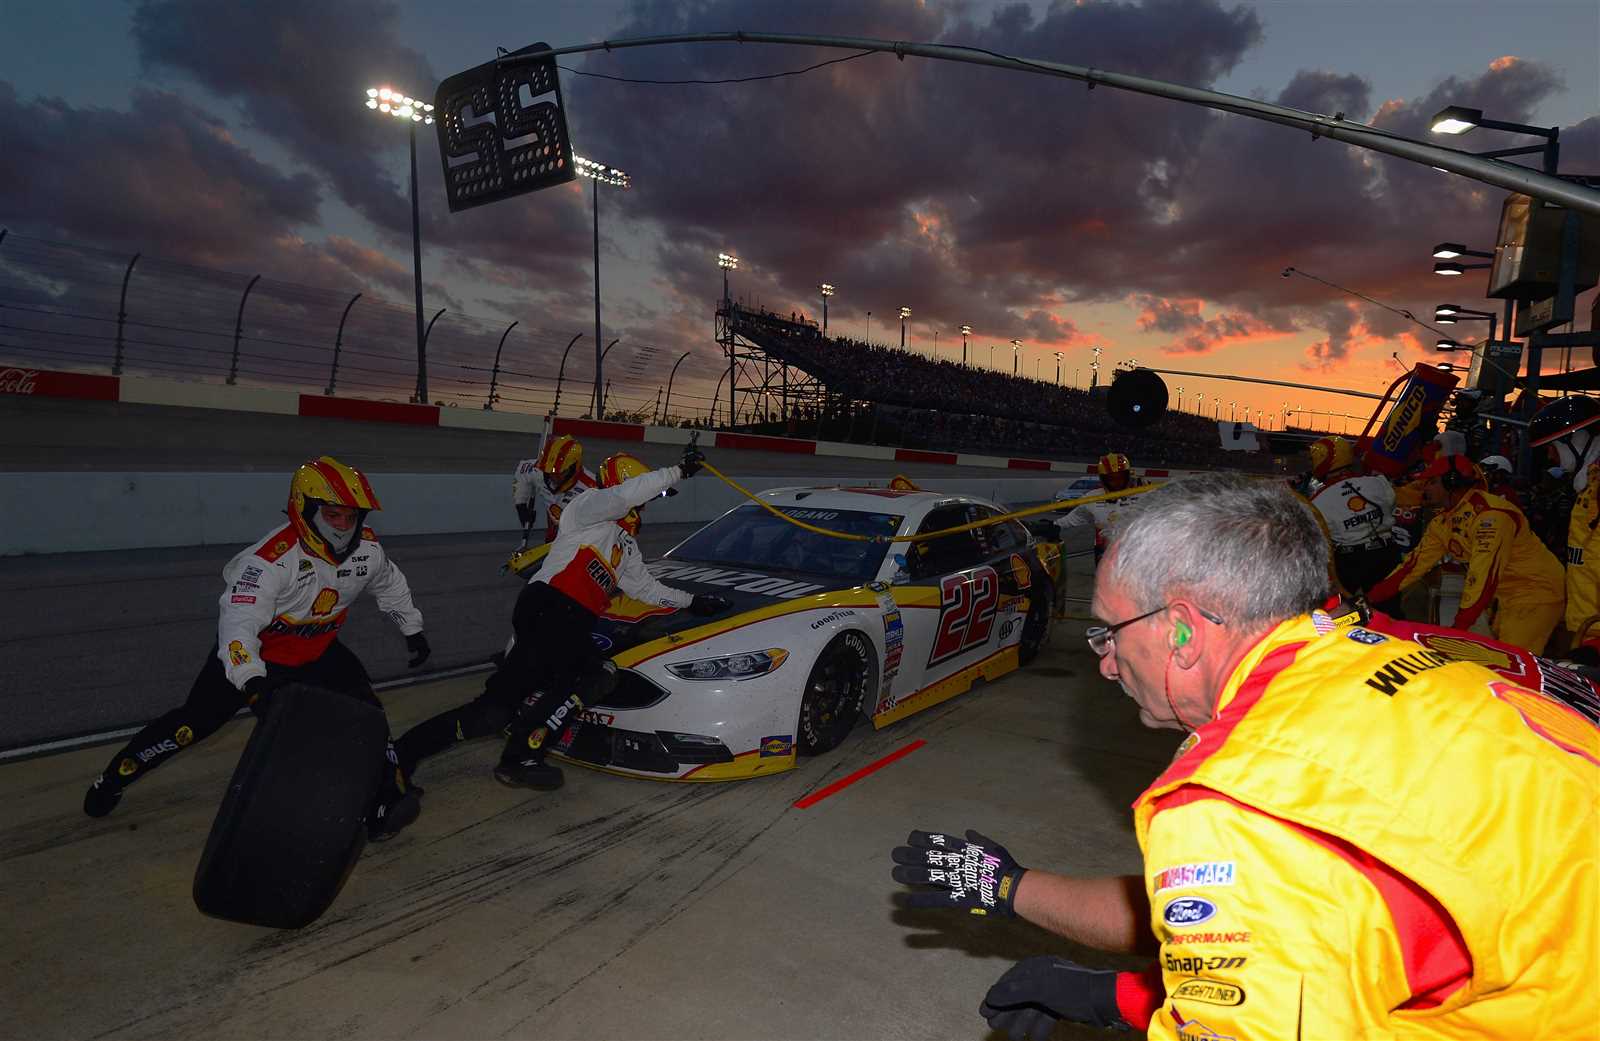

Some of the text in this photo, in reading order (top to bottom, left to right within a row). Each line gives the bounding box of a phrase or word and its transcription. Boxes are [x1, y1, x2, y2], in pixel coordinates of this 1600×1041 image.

[1385, 385, 1424, 451] SUNOCO
[811, 609, 857, 630] GOODYEAR
[927, 565, 999, 670] 22
[1166, 863, 1234, 889] NASCAR
[1169, 901, 1203, 922] Ford
[1165, 953, 1248, 976] Snap-on
